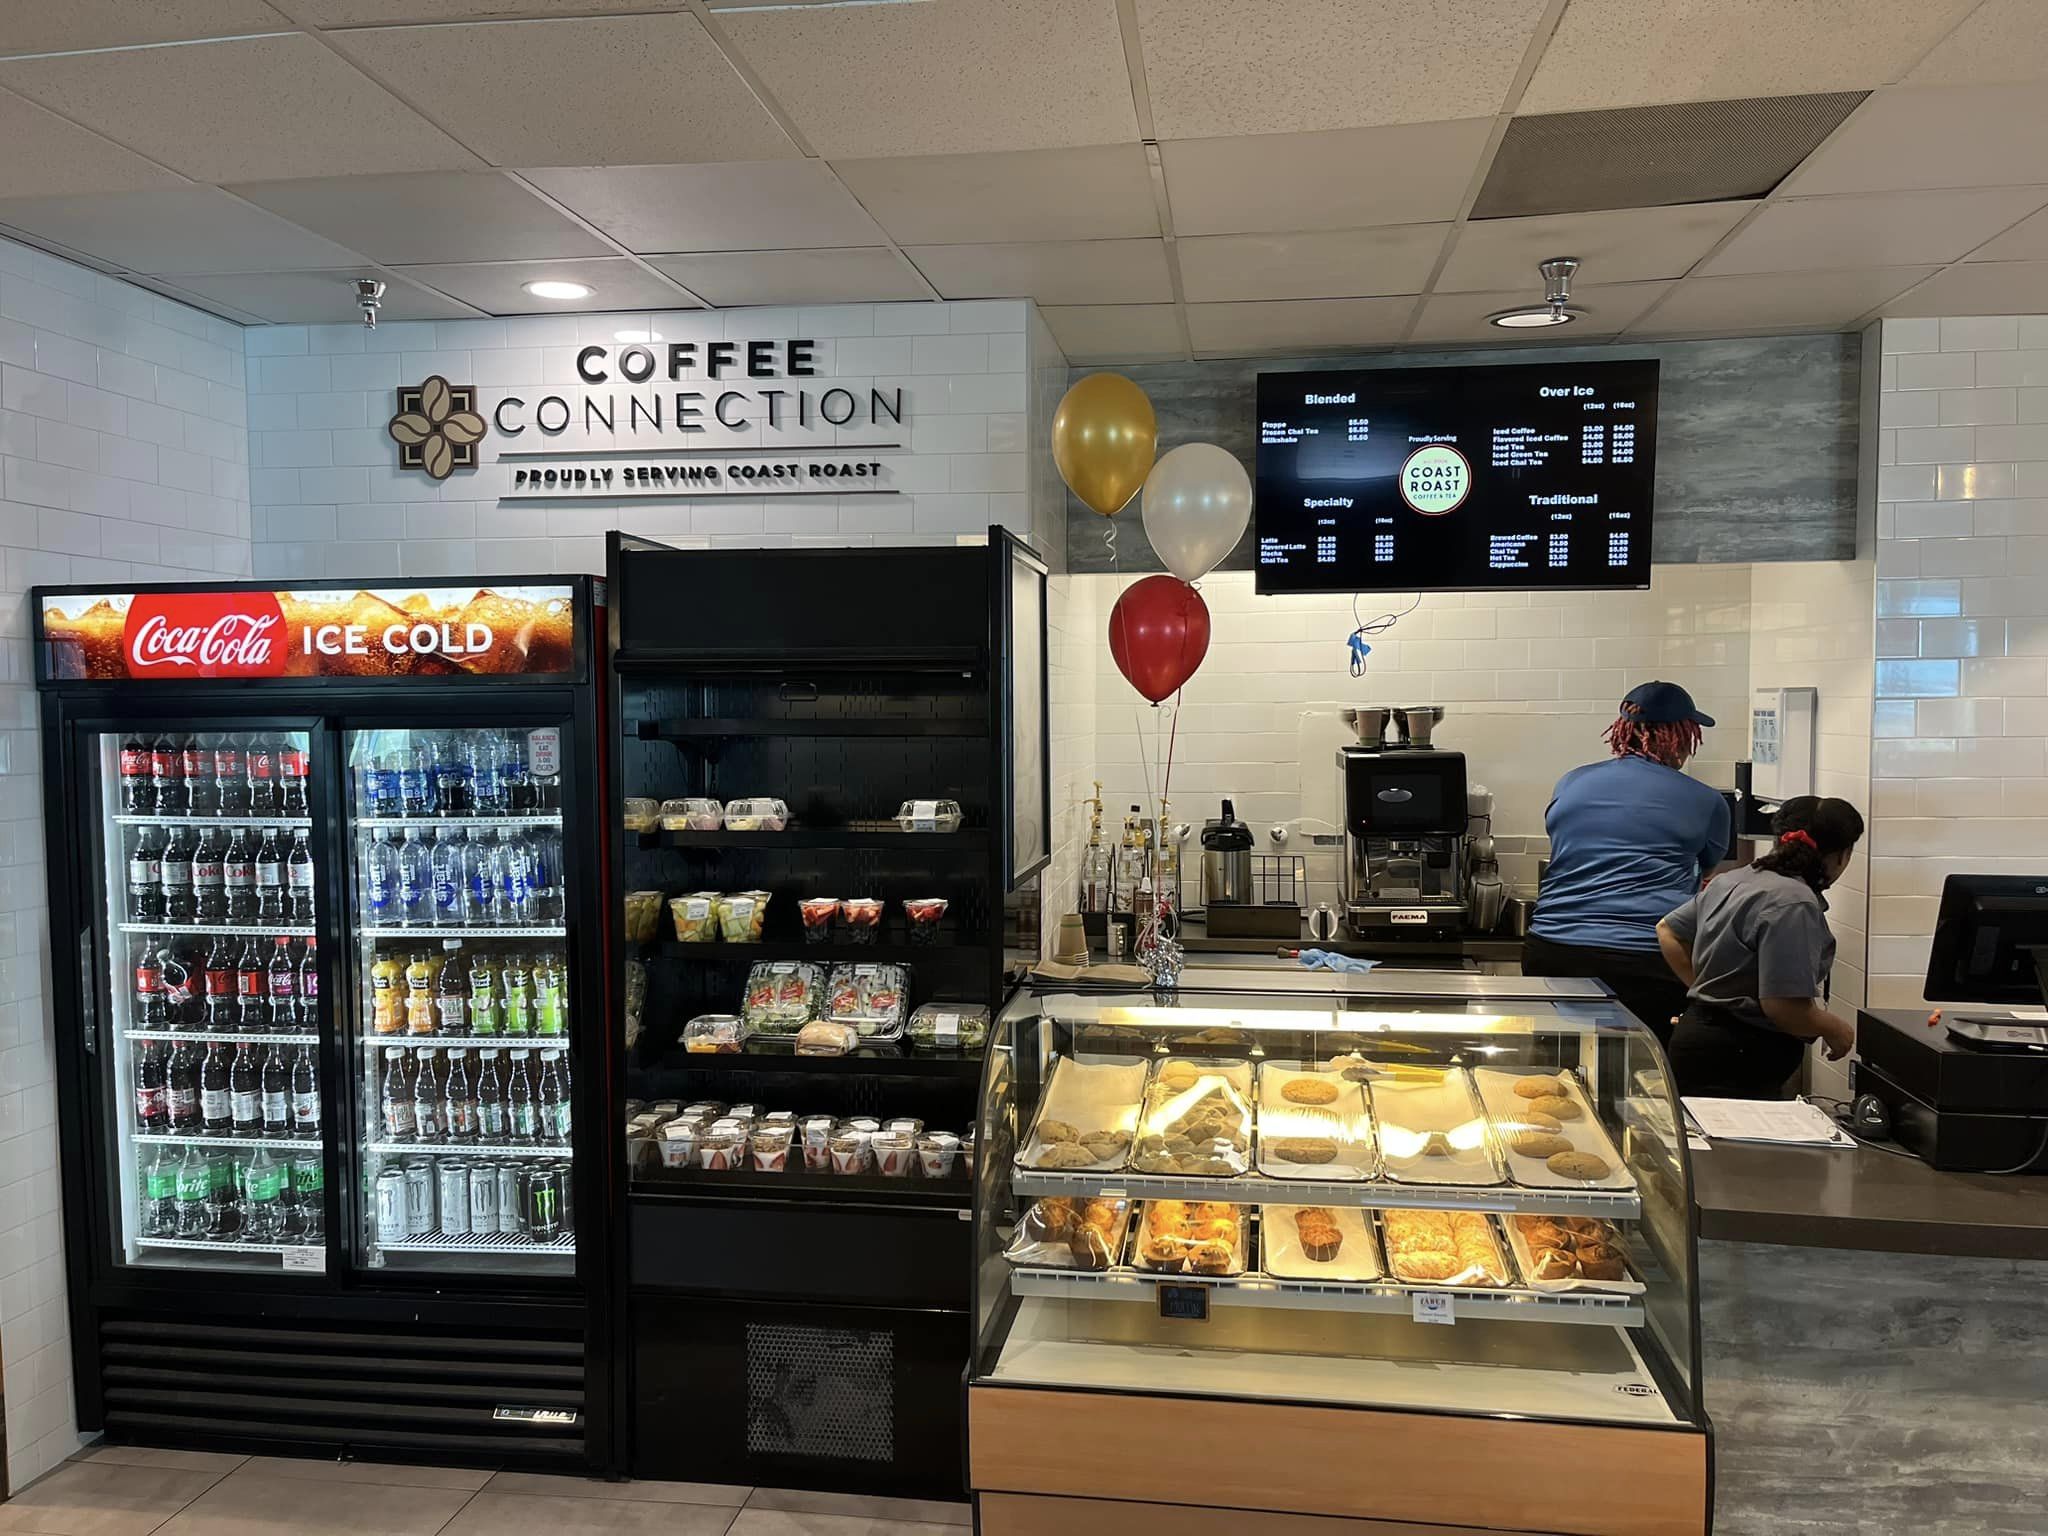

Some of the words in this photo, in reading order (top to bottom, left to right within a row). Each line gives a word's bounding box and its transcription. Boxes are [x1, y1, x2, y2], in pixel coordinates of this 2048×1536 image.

[577, 340, 815, 384] COFFEE
[1539, 387, 1571, 397] Over
[1573, 385, 1595, 396] Ice
[1304, 393, 1356, 405] Blended
[495, 388, 901, 434] CONNECTION
[1511, 427, 1536, 435] Coffee
[1582, 425, 1604, 433] $3.00
[1613, 424, 1635, 432] $4.00
[1408, 434, 1433, 443] Proudly
[1434, 433, 1457, 442] Serving
[1544, 434, 1569, 442] Coffee
[1510, 443, 1525, 451] Tea
[1534, 450, 1549, 458] Tea
[1529, 458, 1543, 466] Tea
[515, 468, 613, 485] PROUDLY
[622, 466, 718, 482] SERVING
[727, 464, 799, 480] COAST
[809, 463, 882, 478] ROAST
[1411, 466, 1461, 478] COAST
[1411, 480, 1460, 492] ROAST
[1303, 497, 1354, 509] Specialty
[1528, 493, 1599, 505] Traditional
[1489, 561, 1529, 569] Cappuccino
[132, 614, 280, 666] Coca-Cola
[303, 624, 369, 656] ICE
[382, 622, 493, 655] COLD
[1617, 1386, 1658, 1394] FEDERAL
